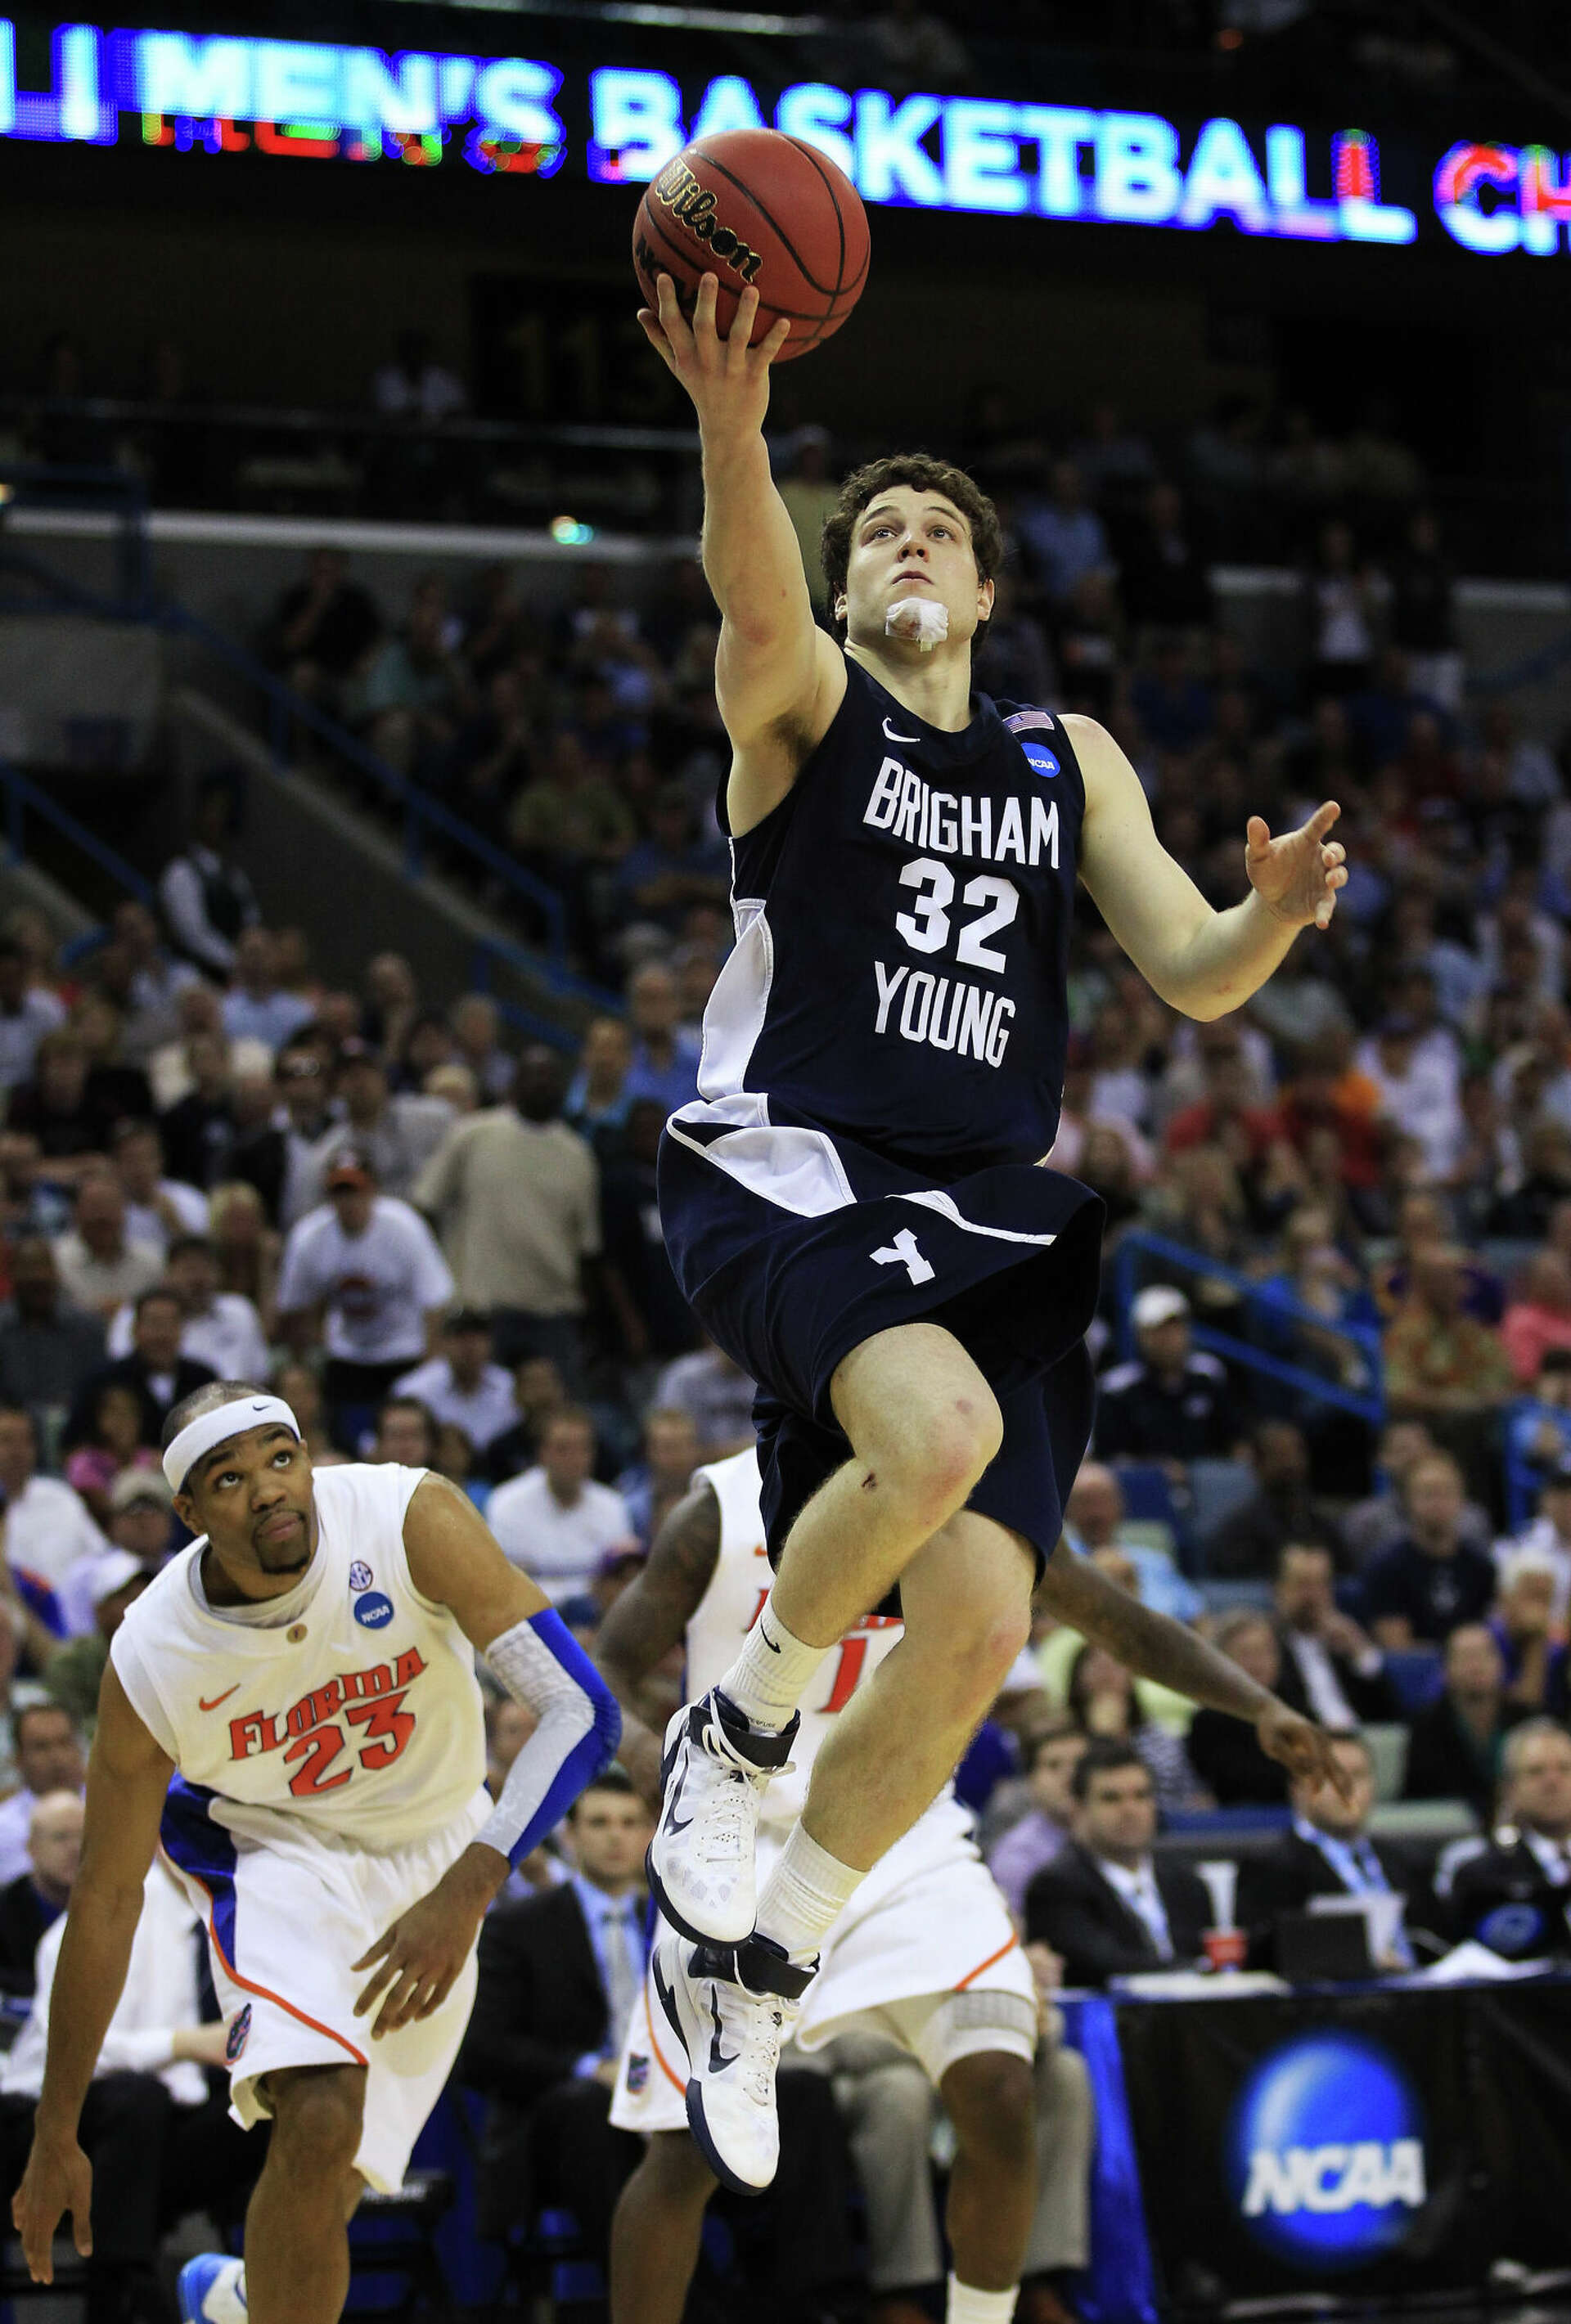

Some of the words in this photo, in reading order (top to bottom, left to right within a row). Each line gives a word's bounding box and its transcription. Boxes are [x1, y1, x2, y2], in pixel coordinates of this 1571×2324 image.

[129, 30, 564, 147] MEN'S
[589, 65, 1419, 245] BASKETBALL
[655, 157, 763, 284] Wilson
[863, 757, 1060, 869] BRIGHAM
[895, 856, 1020, 974] 32
[874, 960, 1016, 1068] YOUNG
[361, 1605, 390, 1624] NCAA
[229, 1646, 429, 1760] FLORIDA
[283, 1690, 416, 1797] 23
[1243, 2137, 1426, 2216] NCAA
